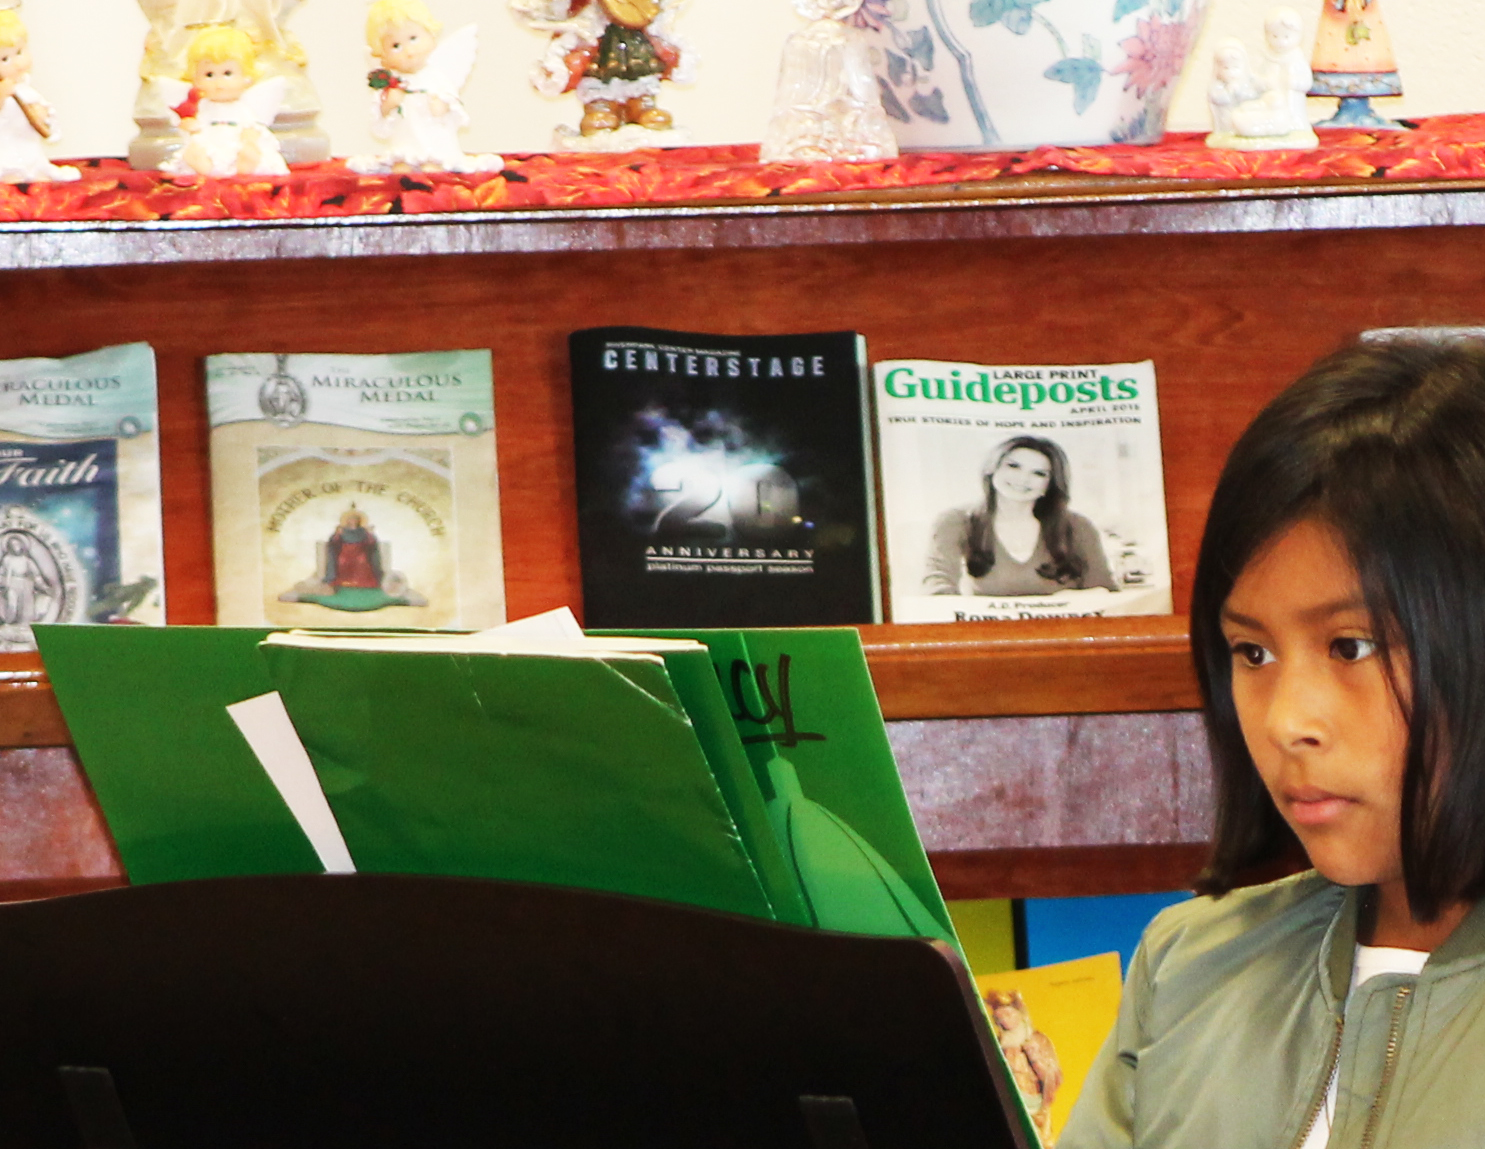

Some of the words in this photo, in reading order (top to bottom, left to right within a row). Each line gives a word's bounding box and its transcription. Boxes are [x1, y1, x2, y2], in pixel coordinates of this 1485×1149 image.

[603, 349, 825, 377] CENTERSTAGE
[993, 369, 1043, 380] LARGE
[1049, 369, 1098, 380] PRINT
[312, 374, 463, 388] MIRACULOUS
[885, 367, 1139, 411] Guideposts
[19, 393, 98, 406] MEDAL
[360, 390, 438, 402] MEDAL
[1070, 405, 1107, 414] APRIL
[888, 416, 917, 425] TRUE
[922, 416, 972, 426] STORIES
[976, 419, 990, 427] OF
[995, 419, 1025, 428] HOPE
[1031, 419, 1057, 428] AND
[1061, 416, 1142, 428] INSPIRATION
[267, 488, 317, 533] MOTHER
[322, 482, 342, 495] OF
[355, 480, 390, 495] THE
[397, 491, 446, 537] CHURCH
[645, 546, 815, 558] ANNIVERSARY
[646, 562, 703, 572] platinum
[706, 563, 764, 574] passport
[767, 564, 815, 574] season
